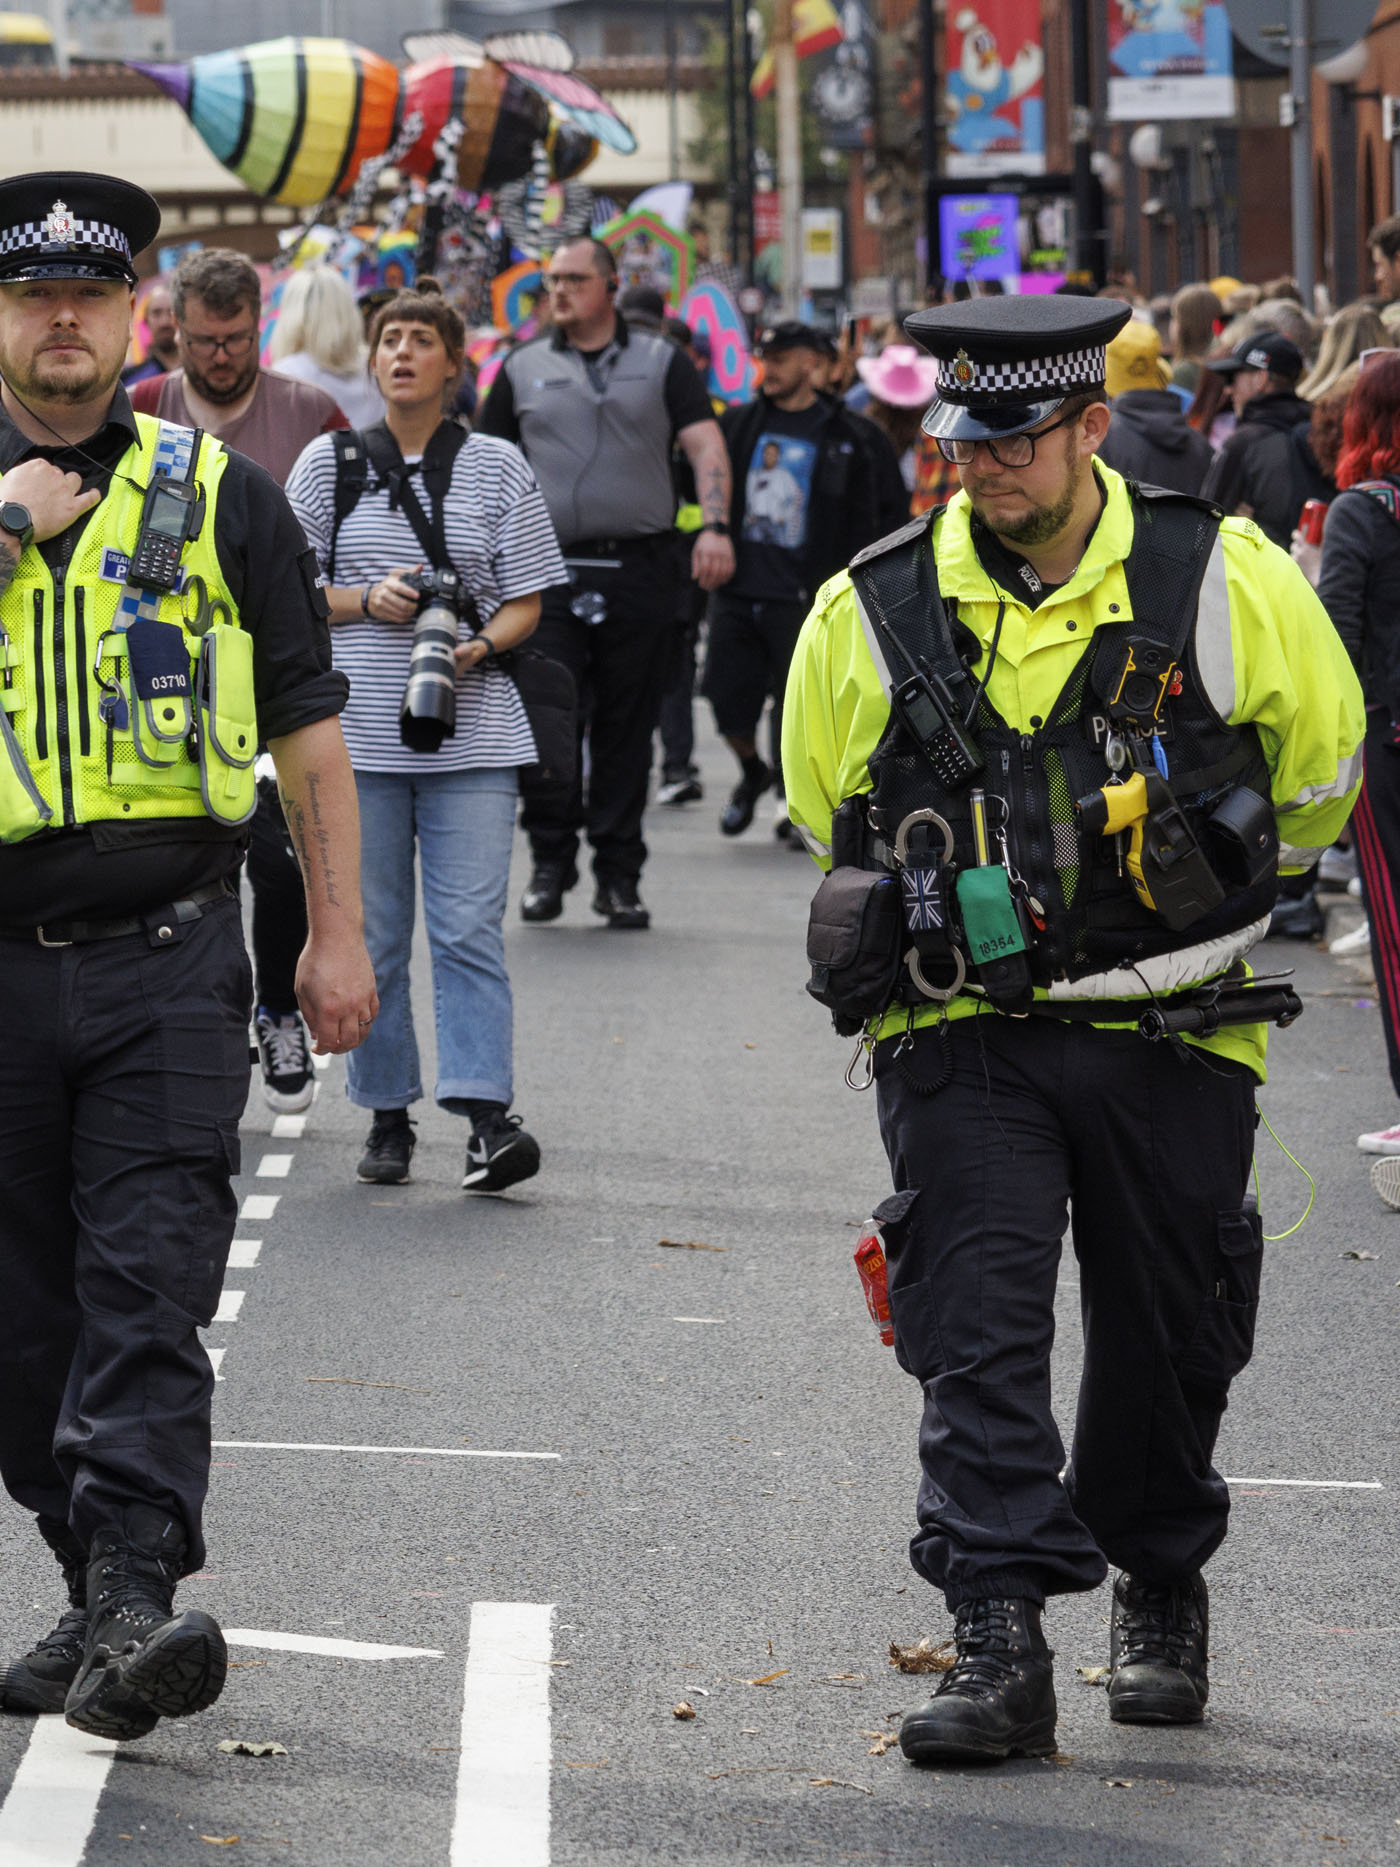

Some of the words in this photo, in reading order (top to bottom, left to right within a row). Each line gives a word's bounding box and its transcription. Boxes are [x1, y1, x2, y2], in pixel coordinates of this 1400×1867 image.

[1017, 565, 1041, 593] POLICE
[151, 674, 187, 690] 03710
[979, 934, 1016, 957] 18354
